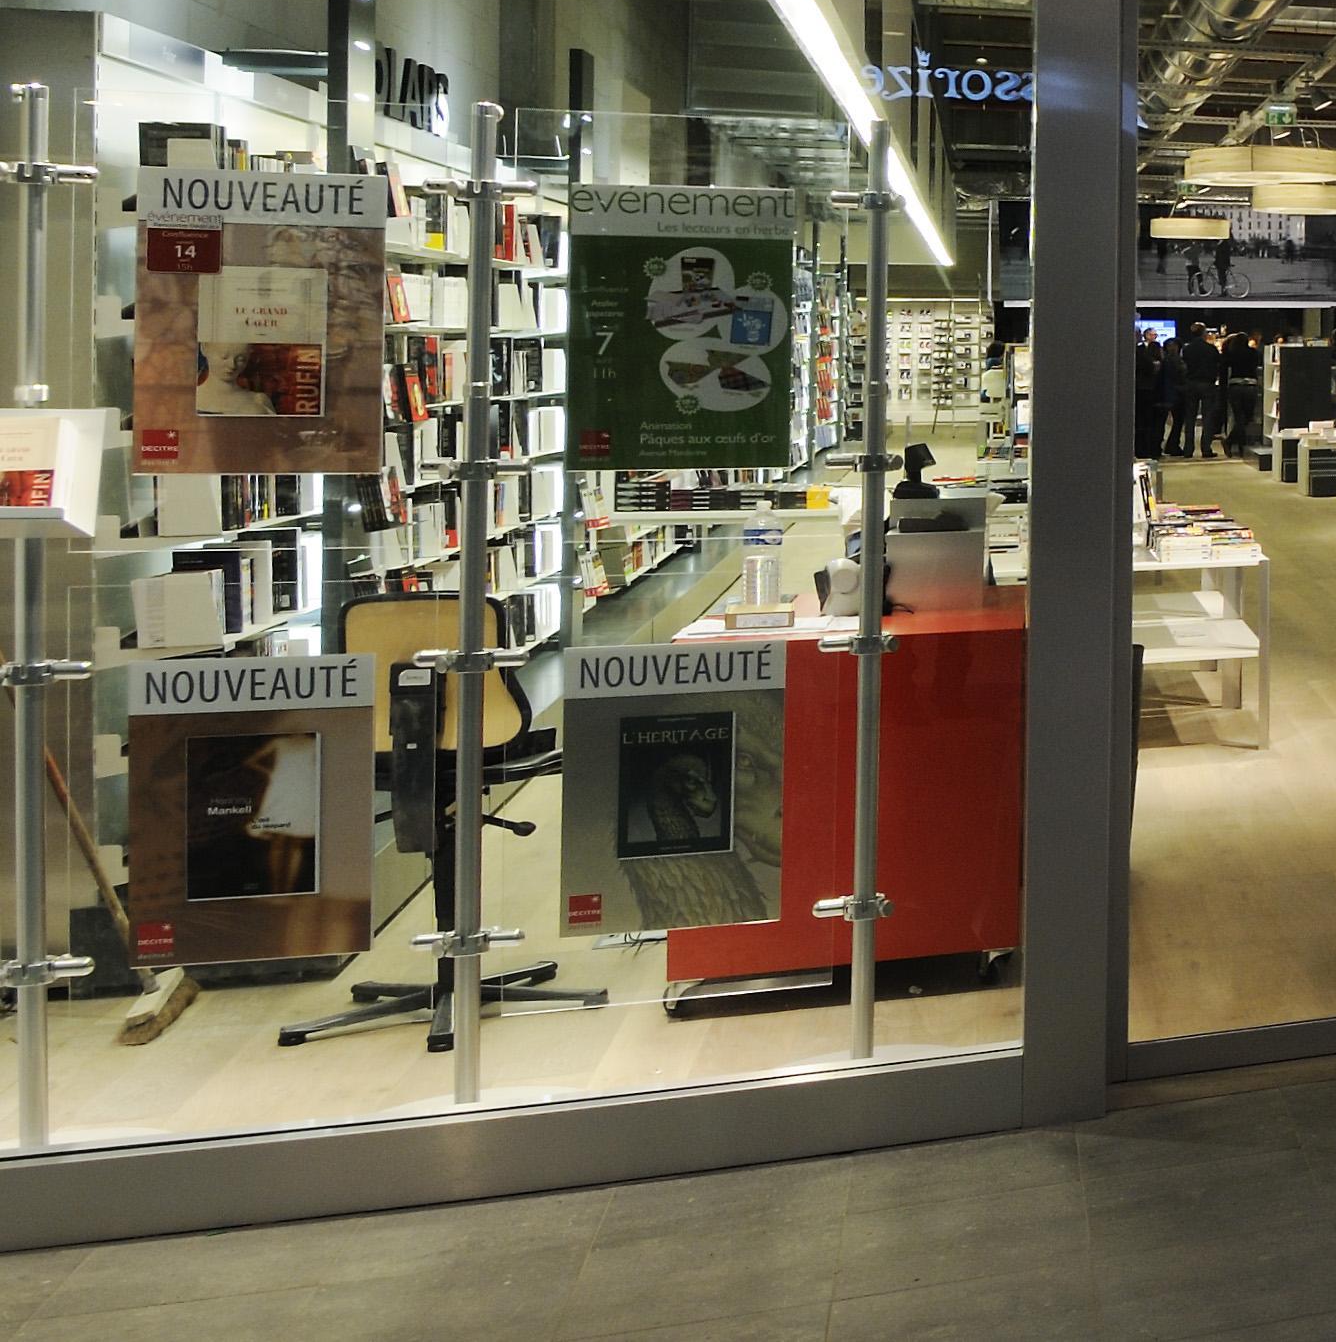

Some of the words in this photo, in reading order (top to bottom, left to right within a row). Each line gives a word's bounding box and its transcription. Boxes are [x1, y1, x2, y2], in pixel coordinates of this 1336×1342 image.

[163, 179, 364, 215] NOUVEAUTÉ
[572, 184, 795, 219] événement
[174, 245, 196, 258] 14
[595, 332, 614, 355] 7
[296, 347, 320, 414] RUFIN
[145, 659, 357, 705] NOUVEAUTÉ
[579, 644, 771, 689] NOUVEAUTÉ
[207, 805, 252, 816] Mankell
